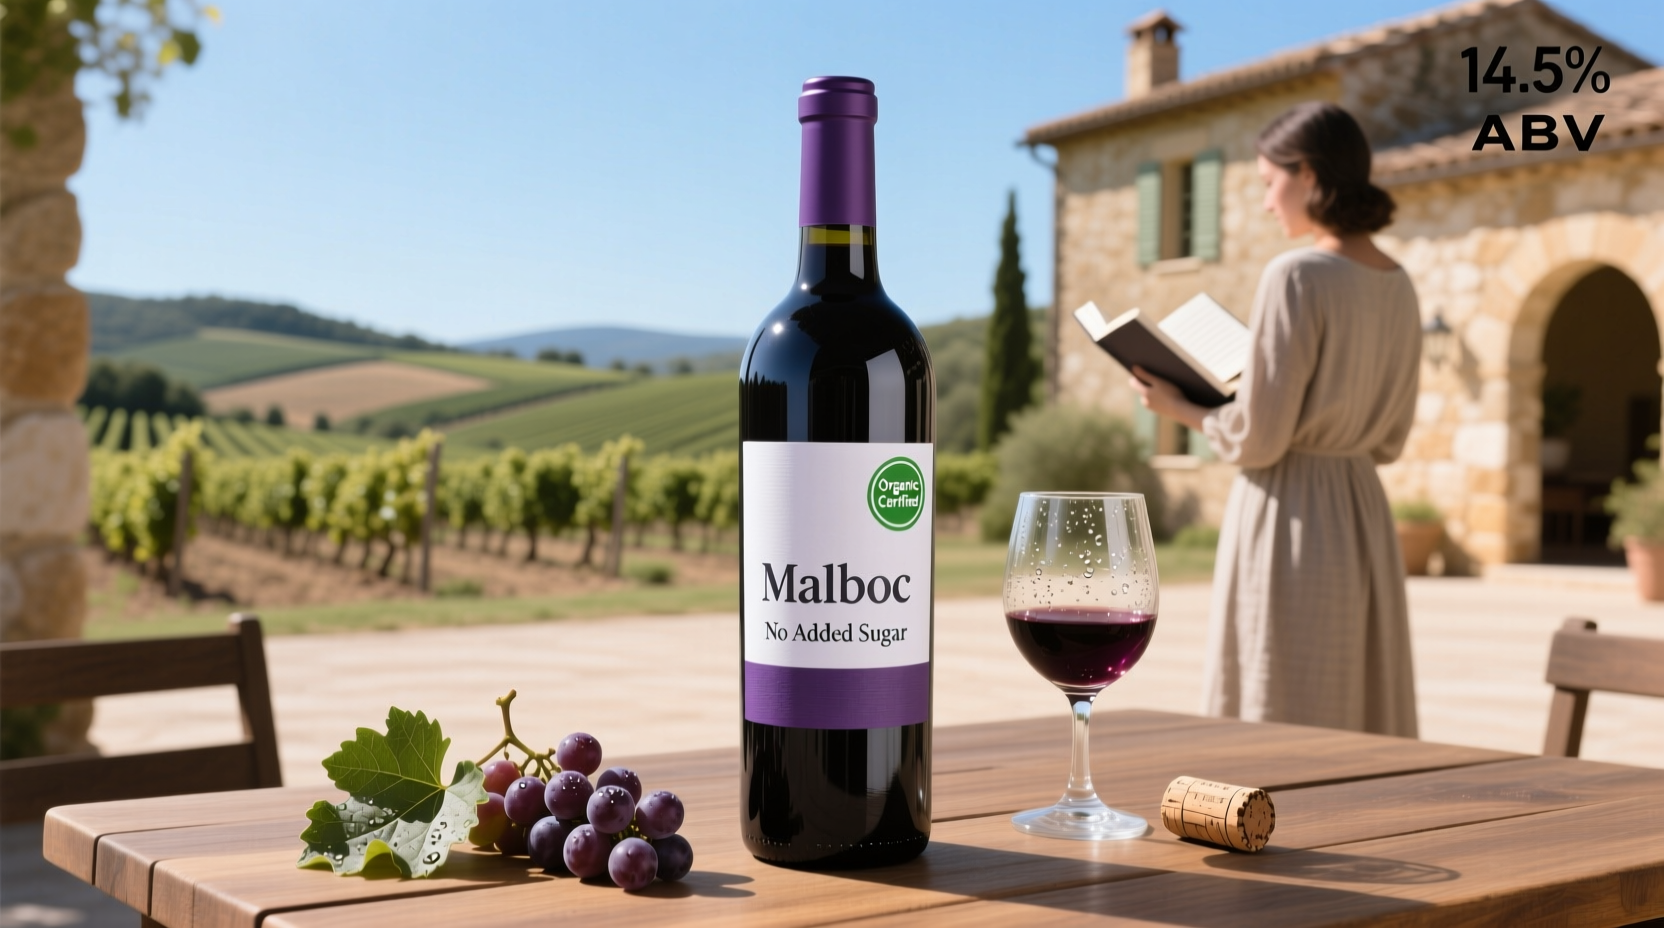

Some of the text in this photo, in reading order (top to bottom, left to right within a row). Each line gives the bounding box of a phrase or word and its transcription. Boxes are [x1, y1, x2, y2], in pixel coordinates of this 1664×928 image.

[878, 478, 919, 495] Organic
[762, 562, 911, 604] Malboc
[765, 622, 908, 648] No Added Sugar
